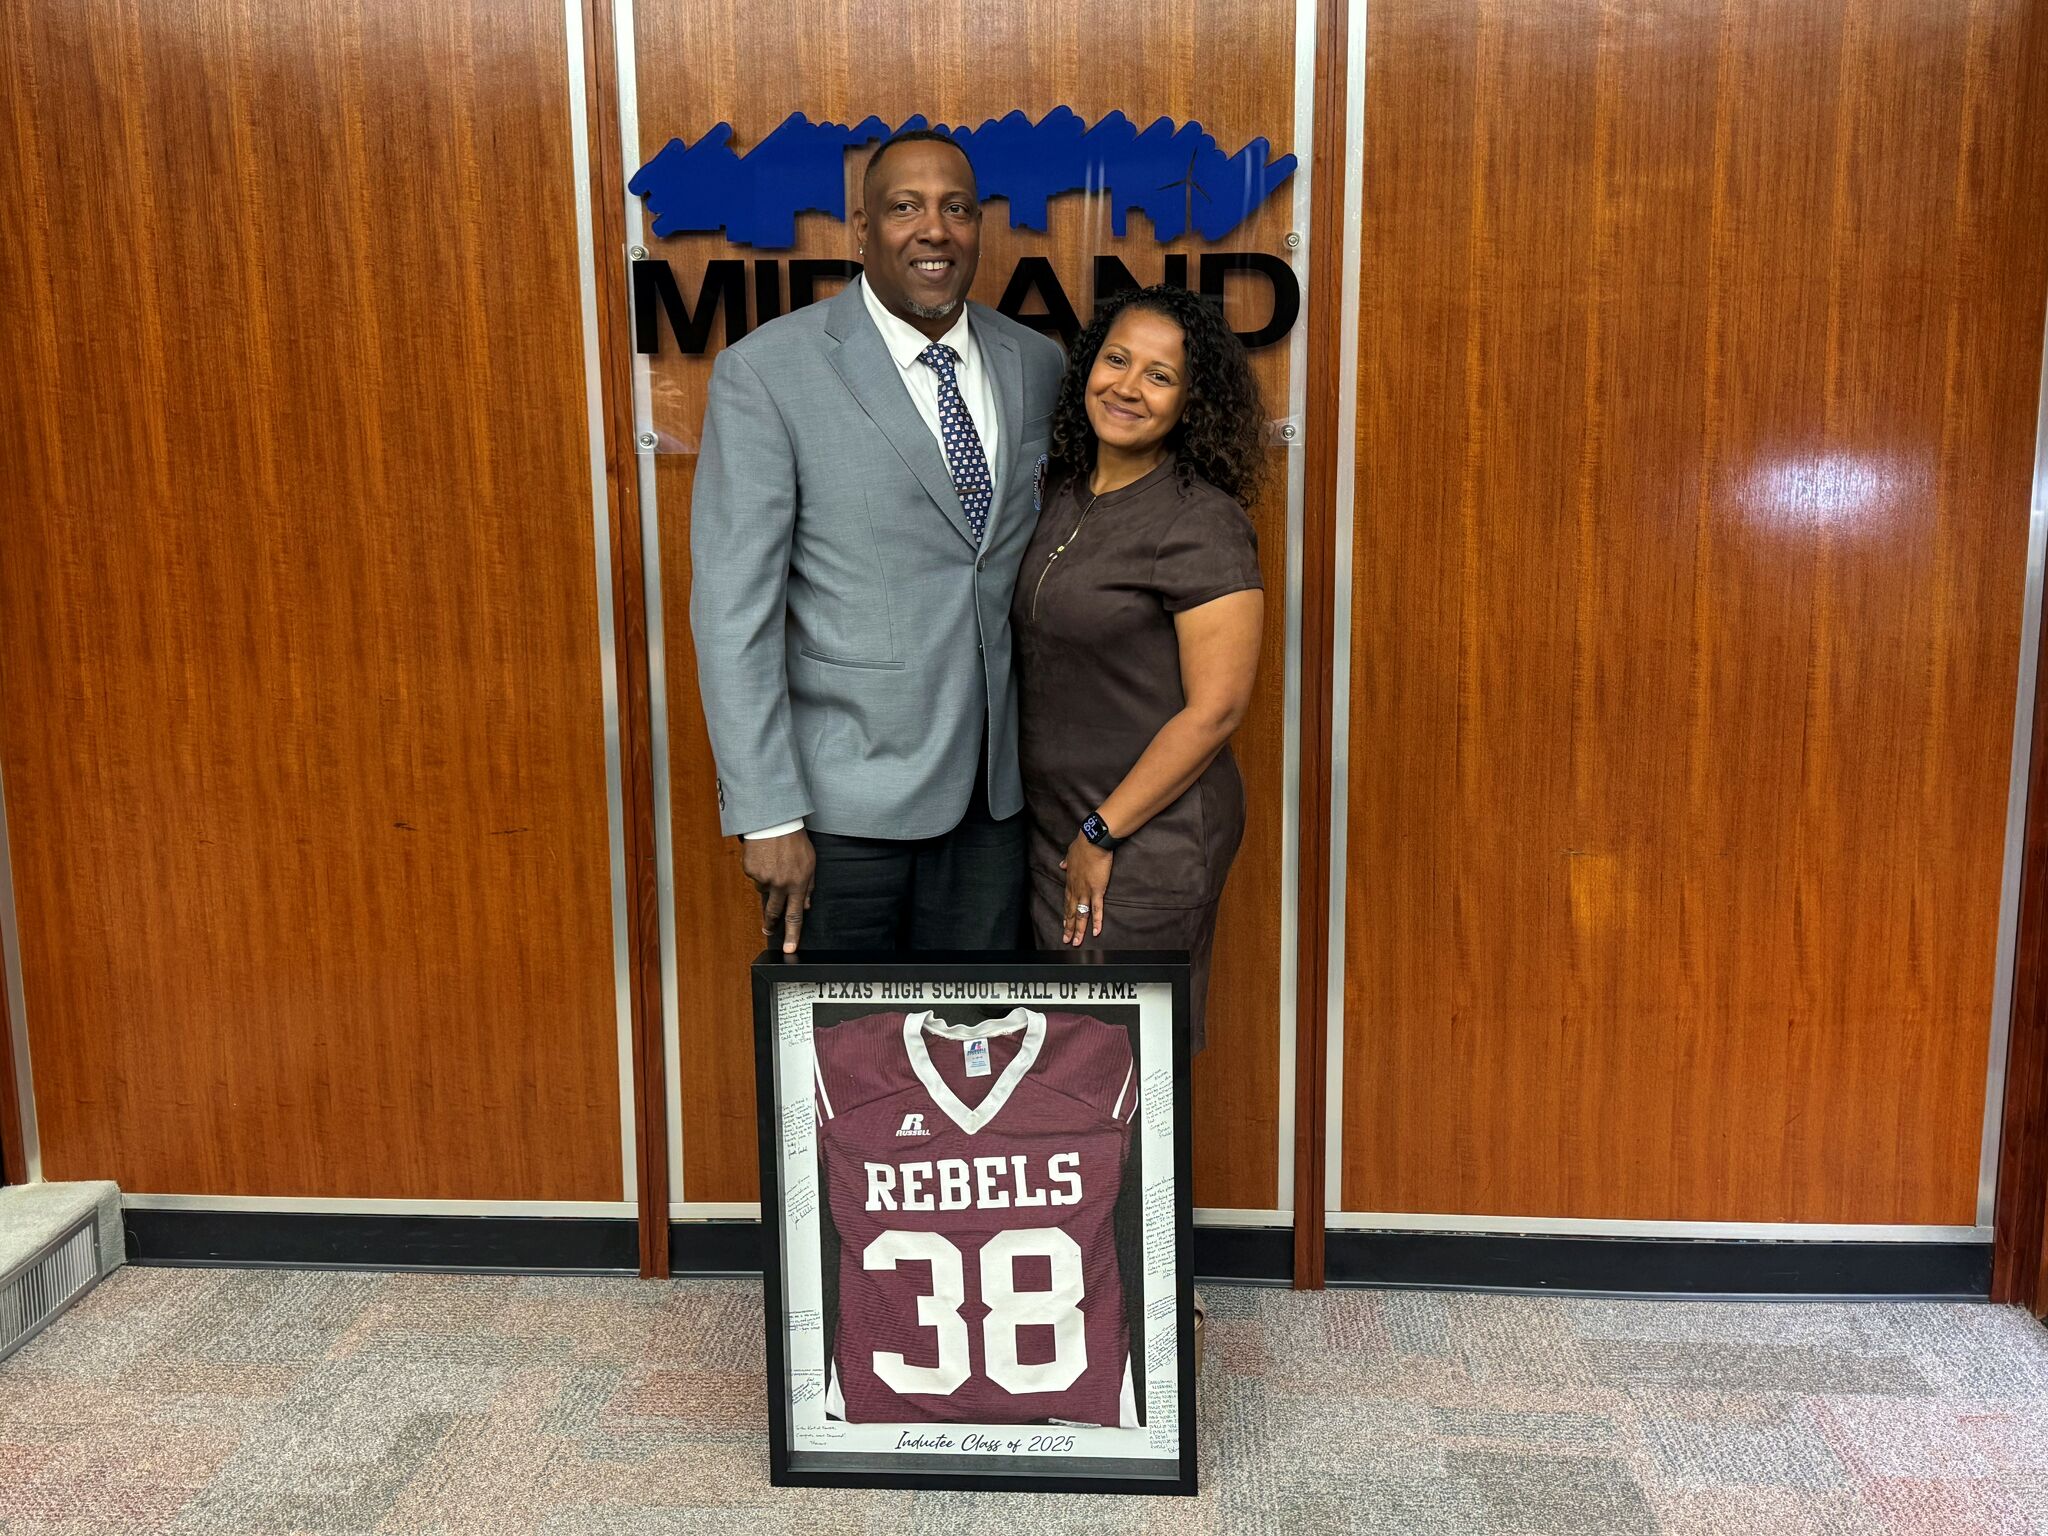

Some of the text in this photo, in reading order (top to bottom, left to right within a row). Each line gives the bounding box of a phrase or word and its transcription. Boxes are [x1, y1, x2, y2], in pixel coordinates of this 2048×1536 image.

[633, 253, 1300, 354] MIAND
[815, 983, 1138, 999] TEXAS HIGH SCHOOL HALL OF FAME
[895, 1129, 932, 1137] RUSSELL
[864, 1152, 1083, 1212] REBELS
[862, 1227, 1088, 1396] 38
[895, 1431, 1076, 1453] Inductee Class of 2025
